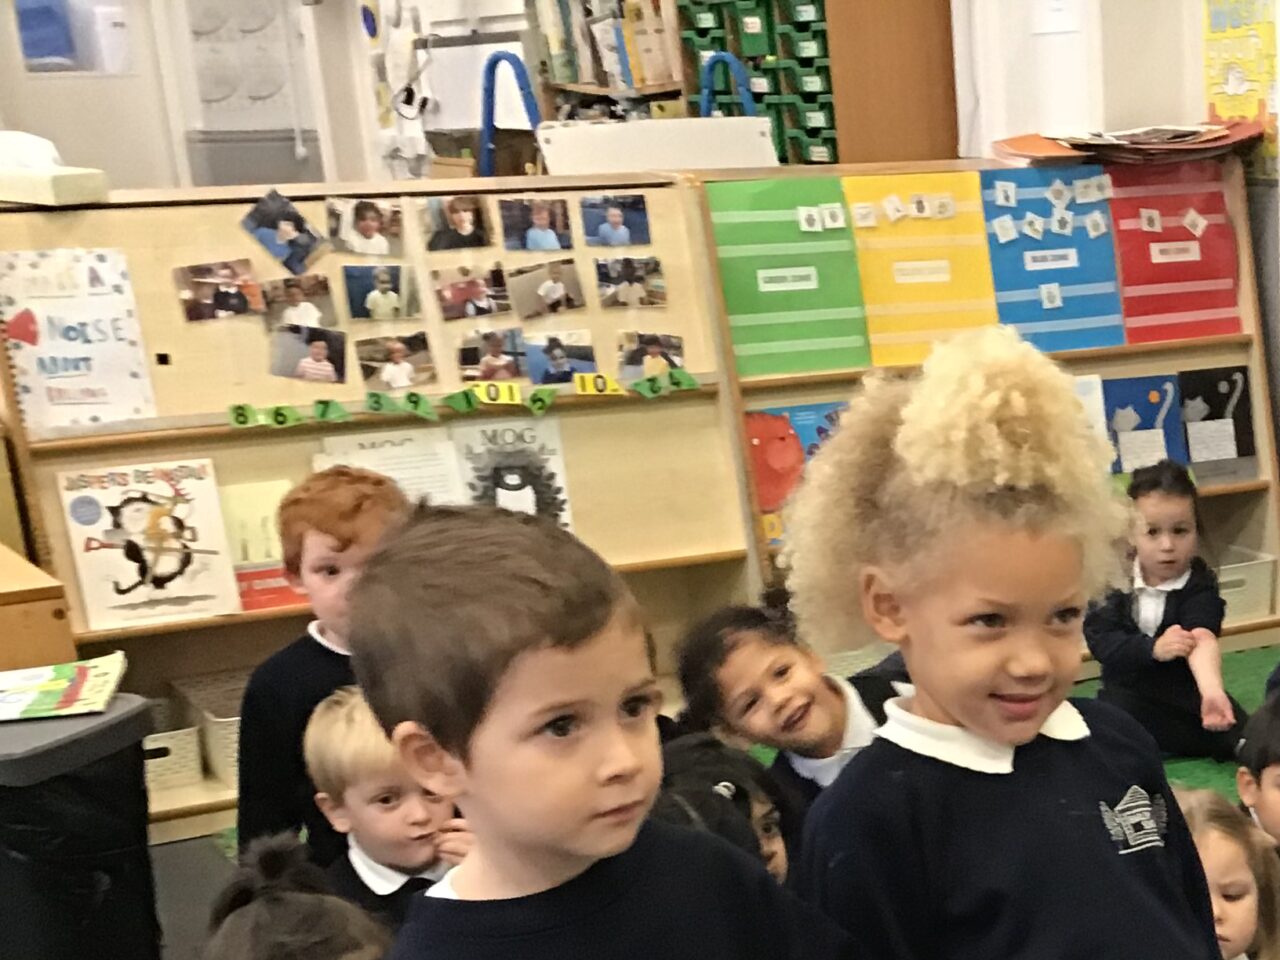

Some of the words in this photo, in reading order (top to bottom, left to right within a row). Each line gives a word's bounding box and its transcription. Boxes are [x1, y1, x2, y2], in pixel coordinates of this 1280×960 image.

[579, 374, 606, 393] 10
[316, 401, 329, 418] 7
[368, 393, 383, 411] 3
[406, 392, 420, 412] 9
[235, 405, 248, 425] 8
[274, 407, 287, 425] 6
[480, 428, 536, 446] MOG
